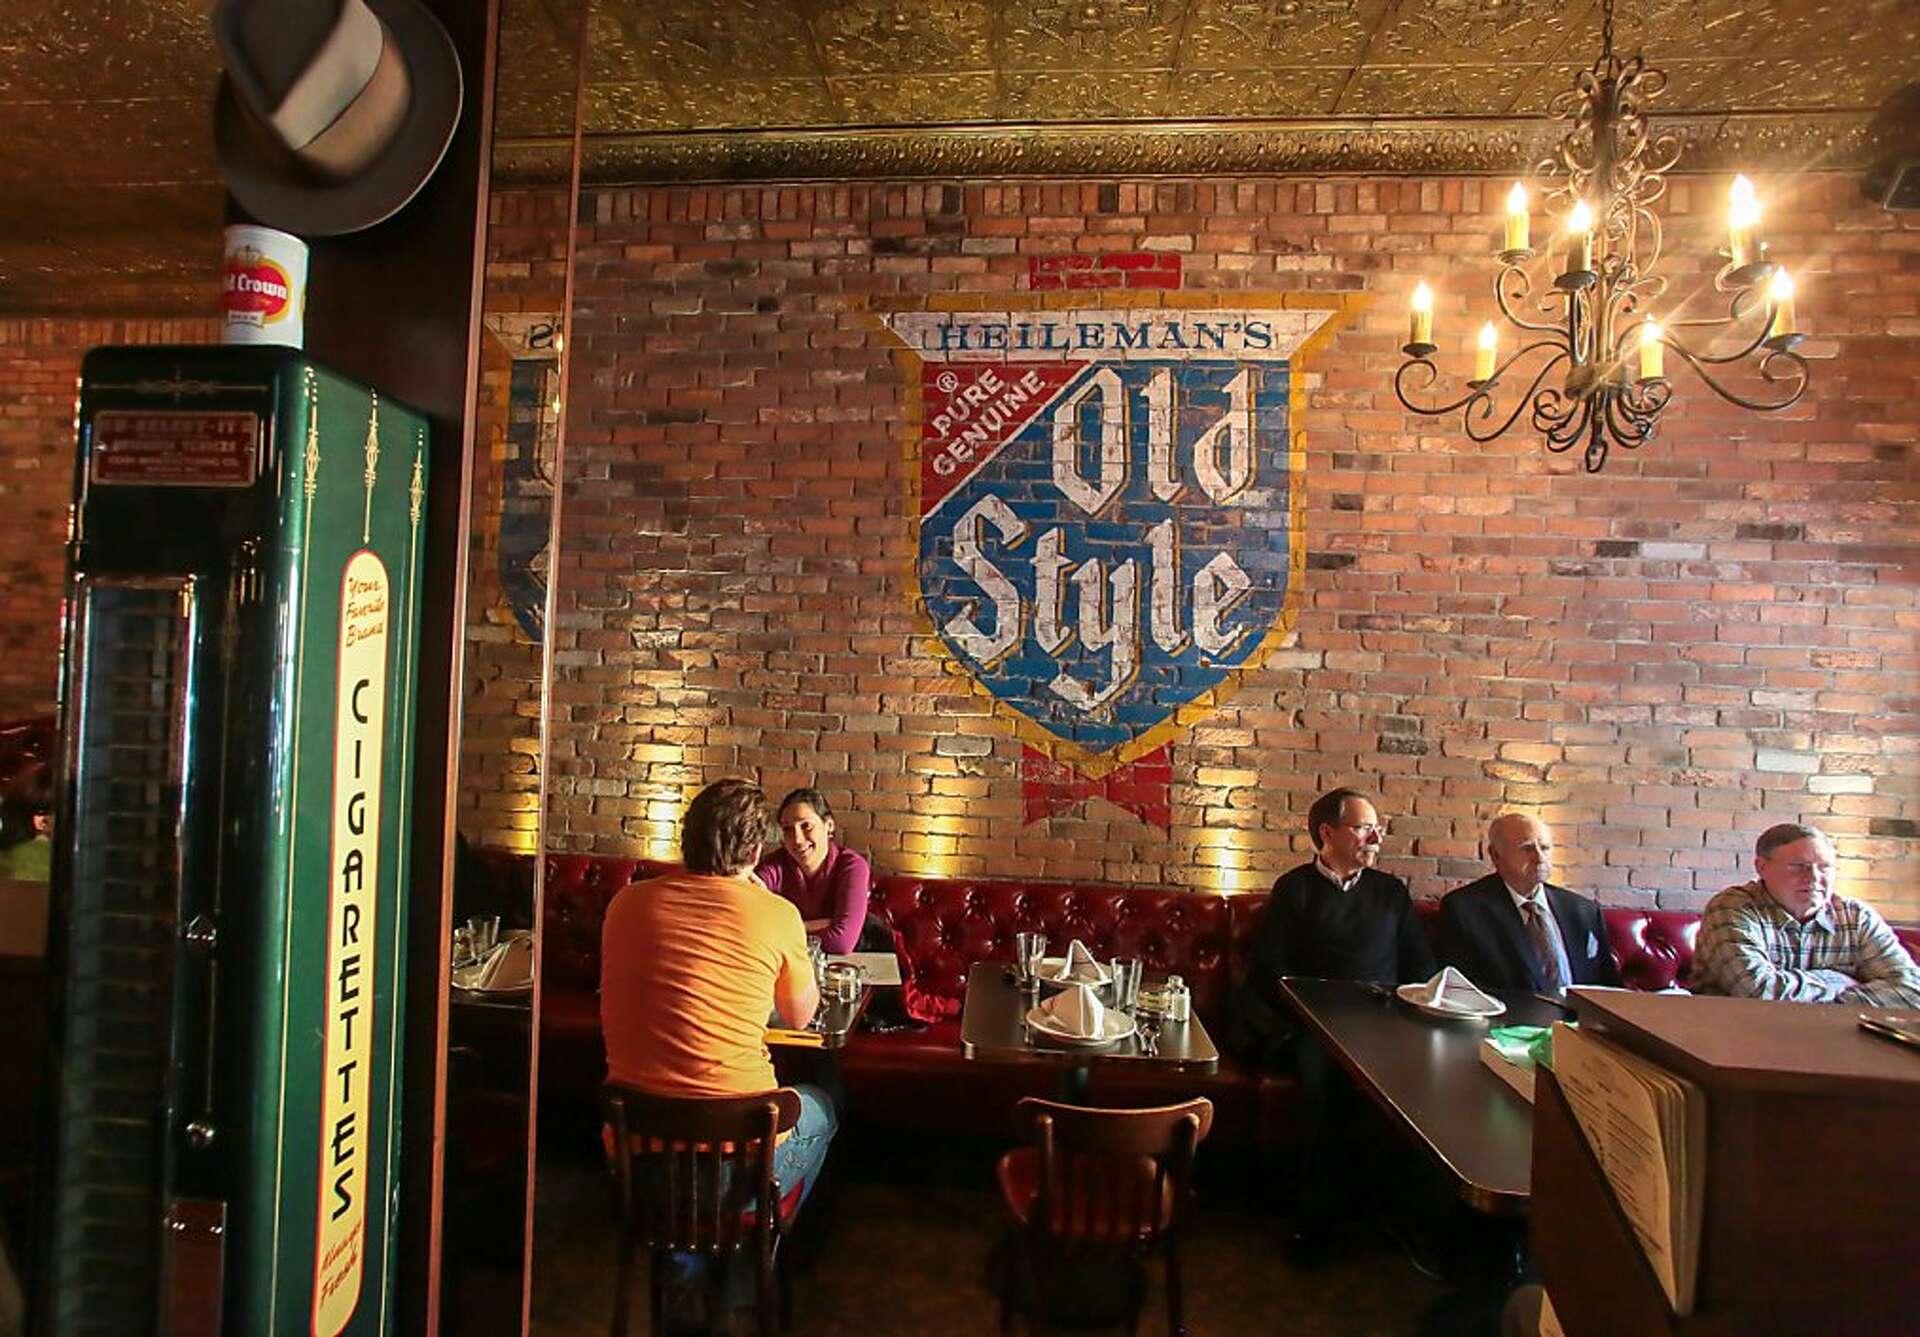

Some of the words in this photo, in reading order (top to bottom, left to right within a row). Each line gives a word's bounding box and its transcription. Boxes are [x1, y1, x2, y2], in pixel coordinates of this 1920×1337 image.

[238, 273, 288, 300] Crown
[936, 320, 1273, 351] HEILEMAN'S
[931, 368, 1005, 438] PURE
[932, 370, 1046, 475] GENUINE
[1053, 366, 1259, 516] Old
[944, 494, 1255, 711] Style
[331, 679, 370, 1221] CIGARETTES
